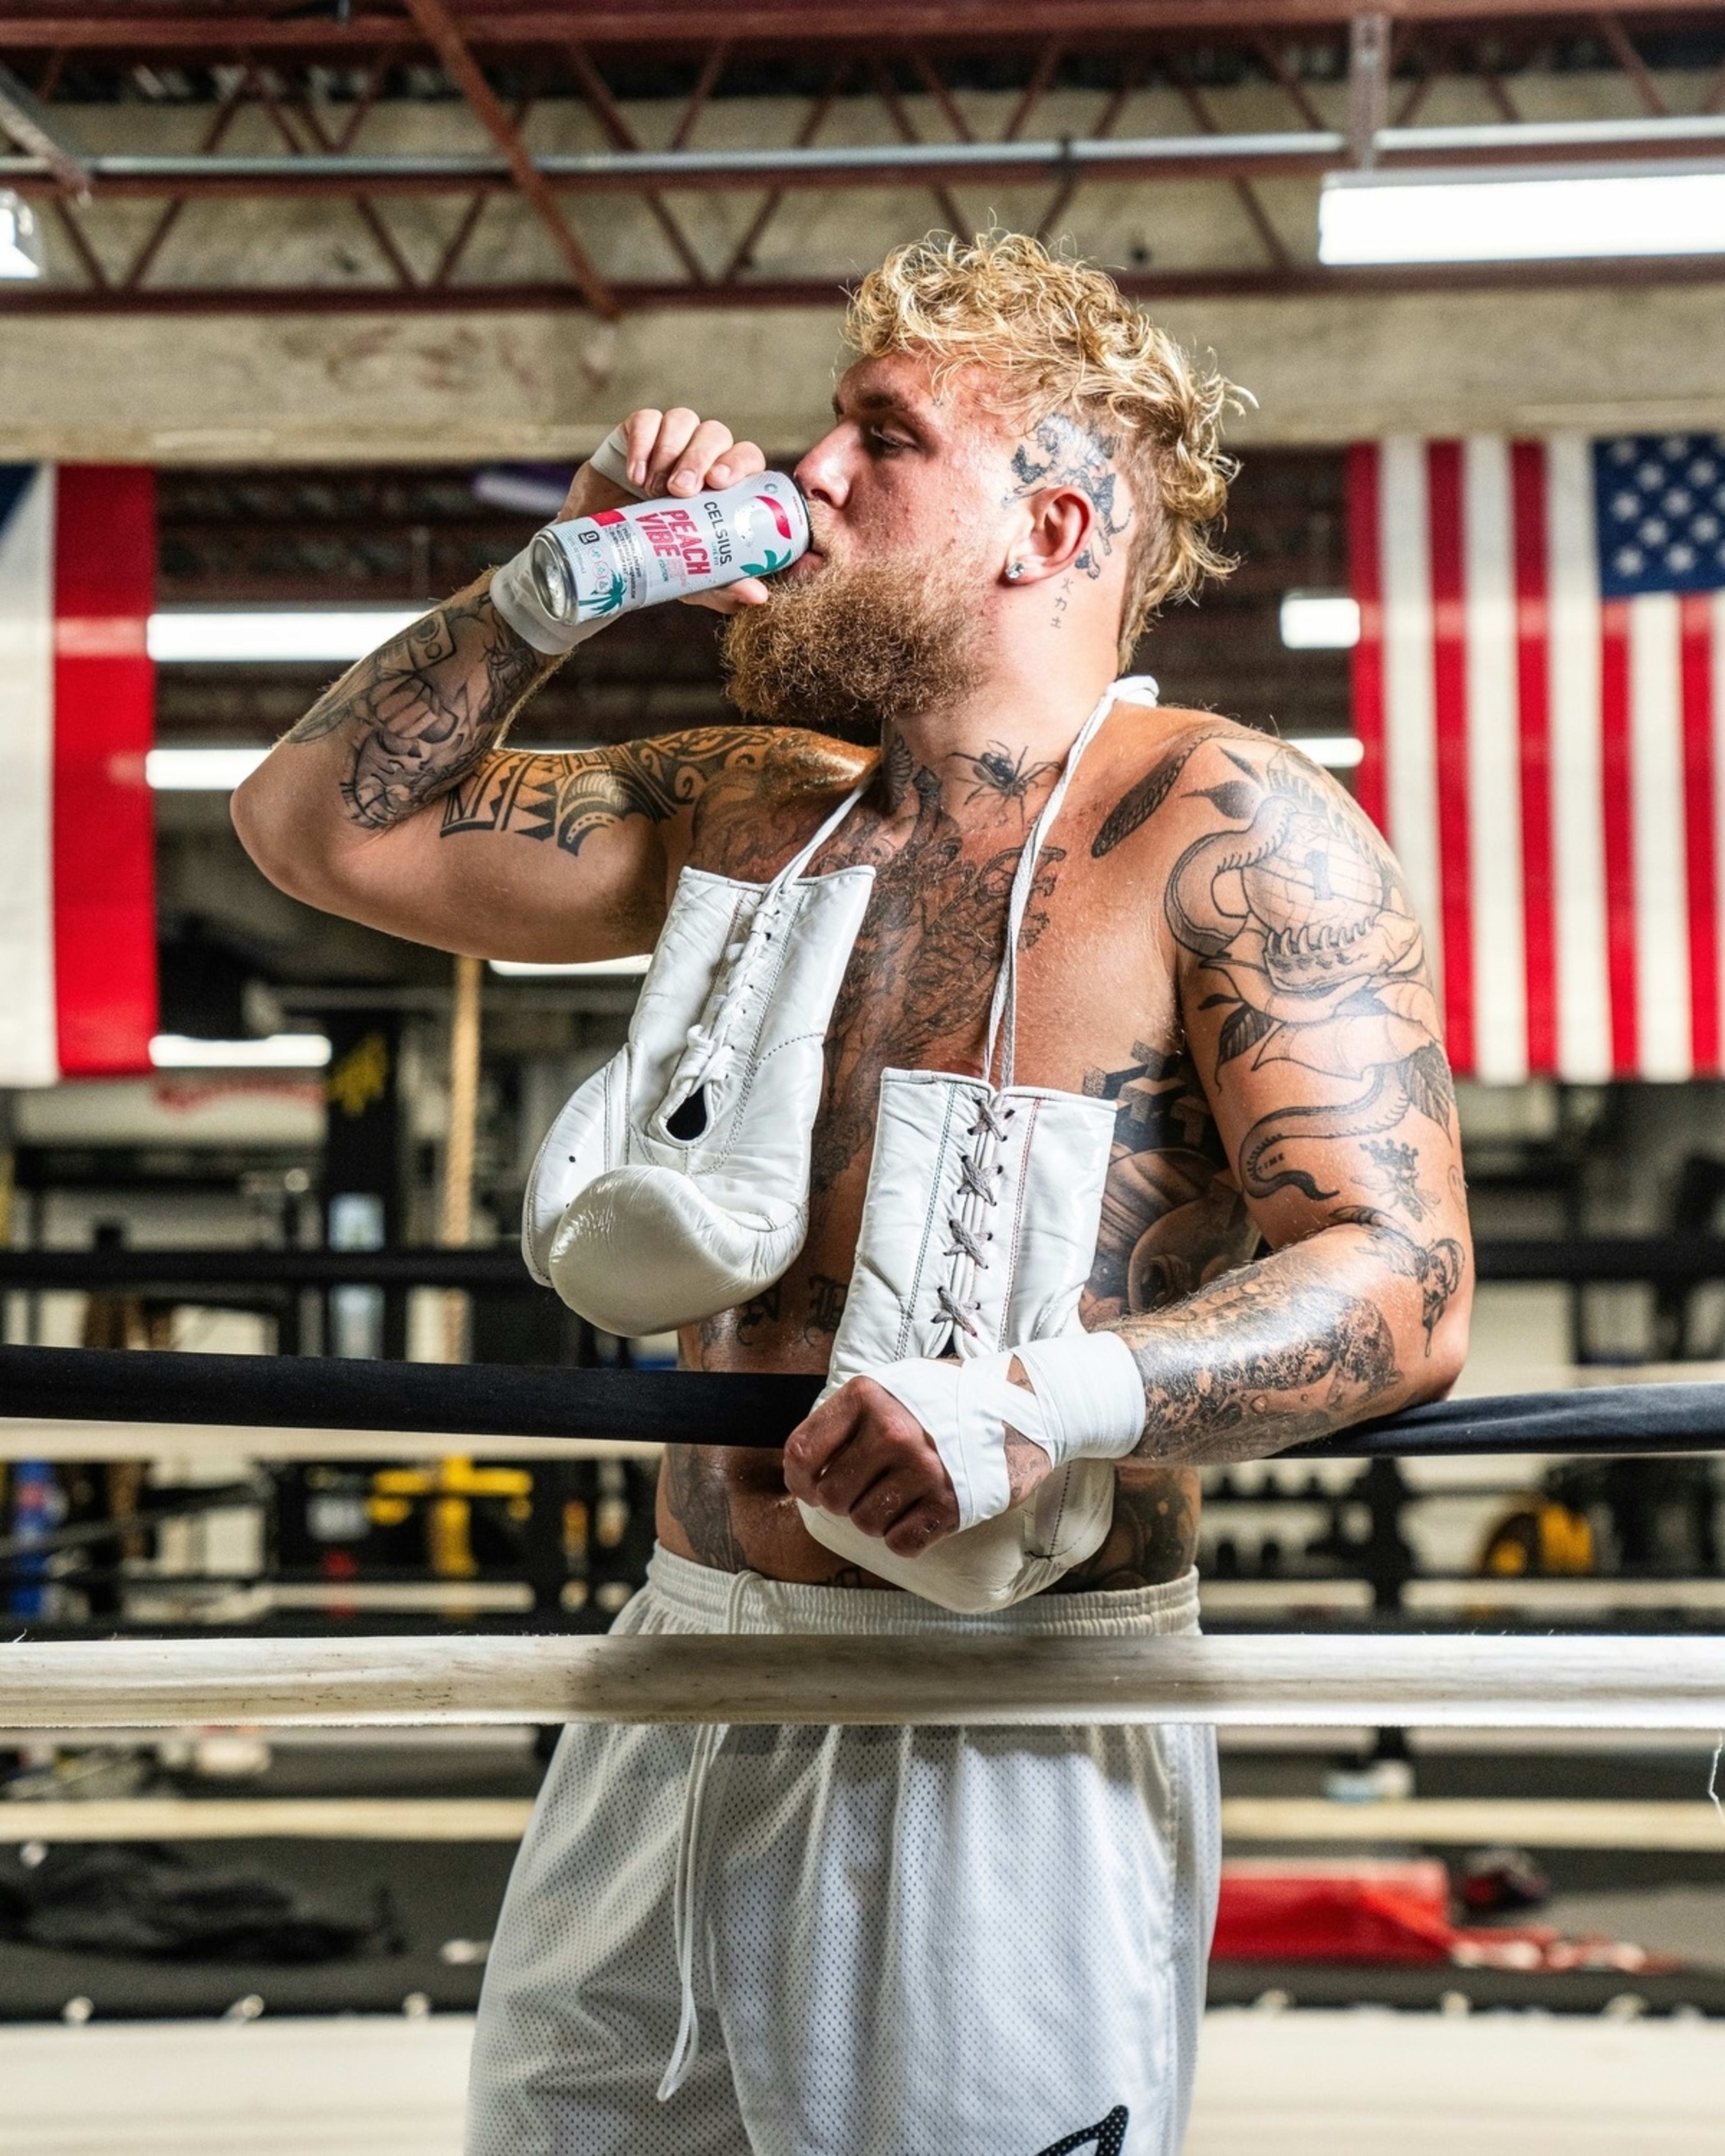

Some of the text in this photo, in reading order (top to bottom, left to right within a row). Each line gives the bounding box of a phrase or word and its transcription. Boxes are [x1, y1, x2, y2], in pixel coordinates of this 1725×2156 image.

[635, 513, 681, 557] VIBE
[659, 510, 711, 574] PEACH
[704, 501, 732, 566] CELSIUS
